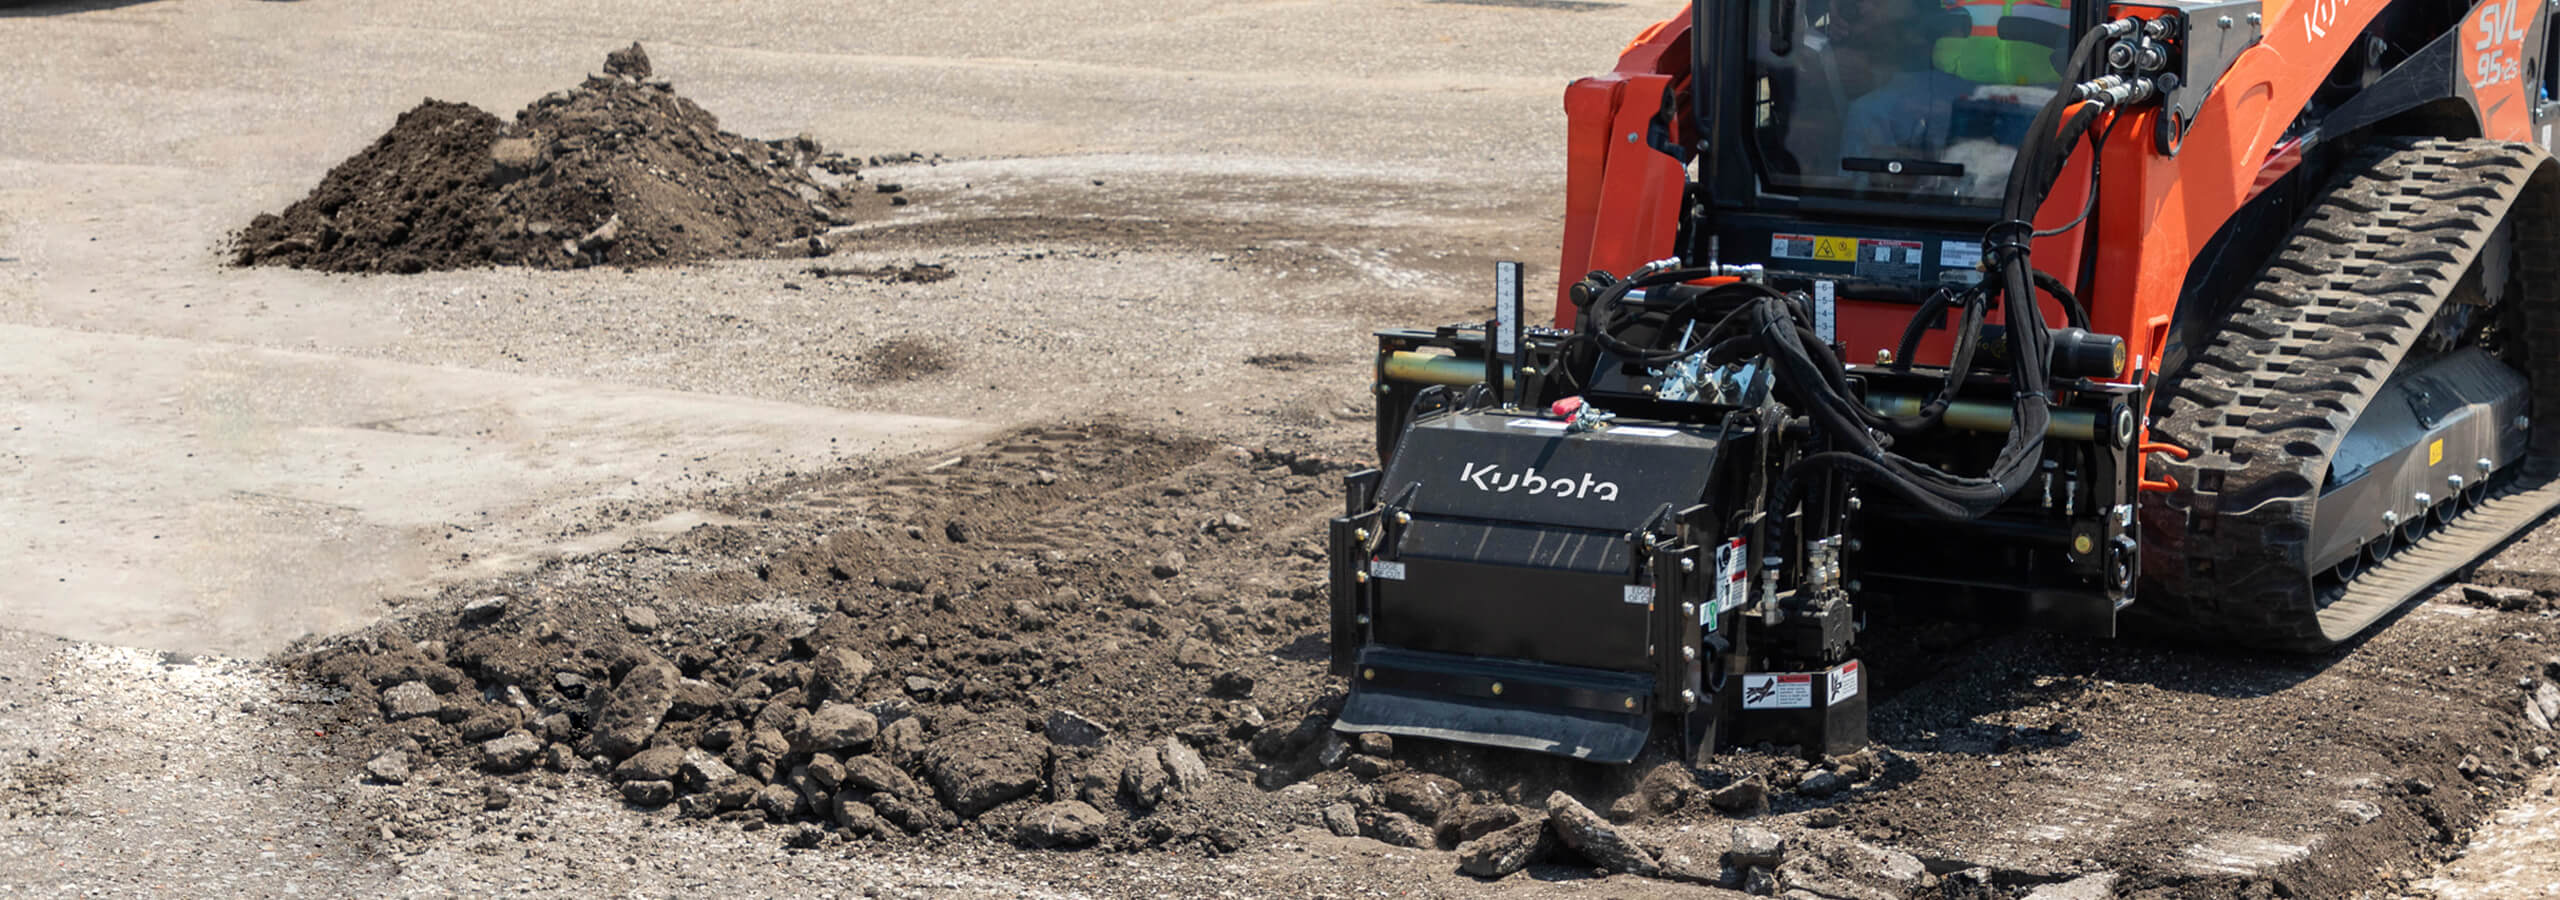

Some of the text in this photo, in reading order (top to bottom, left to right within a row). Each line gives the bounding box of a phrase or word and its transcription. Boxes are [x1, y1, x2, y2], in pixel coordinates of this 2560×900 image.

[2304, 0, 2349, 43] Ku
[2476, 0, 2524, 50] SVL
[1460, 463, 1619, 501] Kubota
